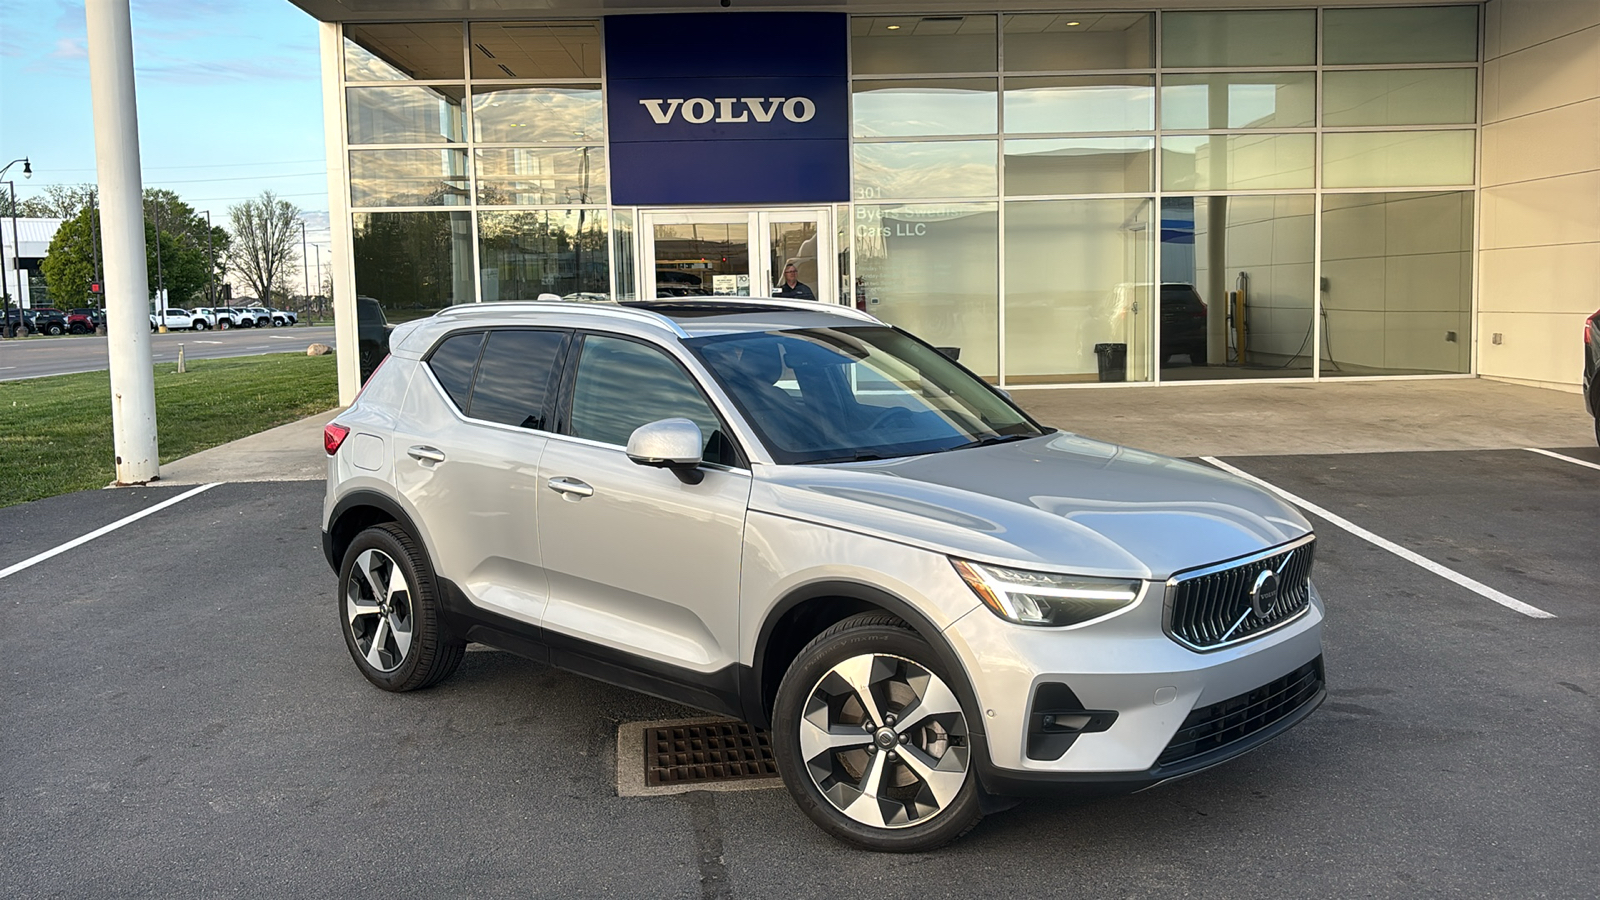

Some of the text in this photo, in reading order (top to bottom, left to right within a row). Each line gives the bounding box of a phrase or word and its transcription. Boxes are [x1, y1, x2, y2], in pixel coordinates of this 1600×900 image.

[639, 97, 816, 124] VOLVO
[856, 187, 881, 199] 301
[856, 206, 899, 222] Byers
[856, 223, 926, 238] Cars LLC
